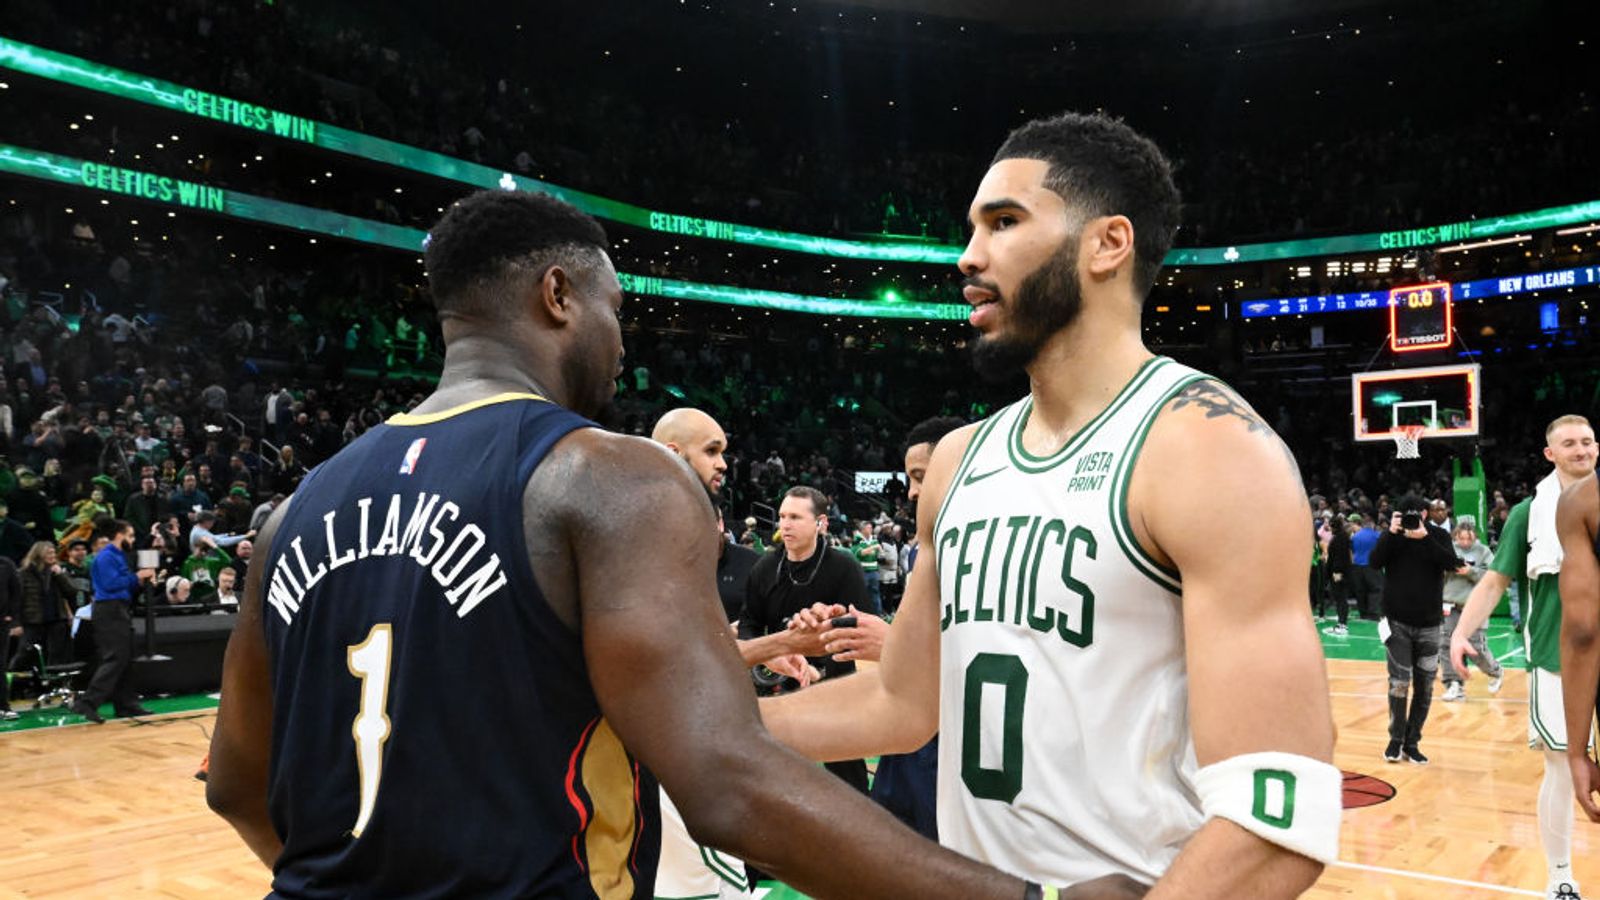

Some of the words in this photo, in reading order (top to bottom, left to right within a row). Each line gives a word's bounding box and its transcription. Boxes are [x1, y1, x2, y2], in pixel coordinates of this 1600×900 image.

[182, 88, 267, 131] CELTICS
[271, 110, 315, 143] WIN
[81, 161, 173, 201] CELTICS
[177, 180, 223, 212] WIN
[650, 211, 702, 236] CELTICS
[705, 220, 734, 241] WIN
[1380, 226, 1437, 249] CELTICS
[1439, 221, 1471, 243] WIN
[634, 276, 663, 295] WIN
[1499, 277, 1523, 294] NEW
[1525, 270, 1575, 290] ORLEANS
[1410, 333, 1447, 344] TISSOT
[1075, 451, 1114, 475] VISTA
[1067, 474, 1107, 493] PRINT
[267, 491, 508, 626] WILLIAMSON
[938, 515, 1098, 649] CELTICS
[346, 622, 394, 839] 1
[961, 652, 1029, 805] 0
[1251, 767, 1297, 830] 0
